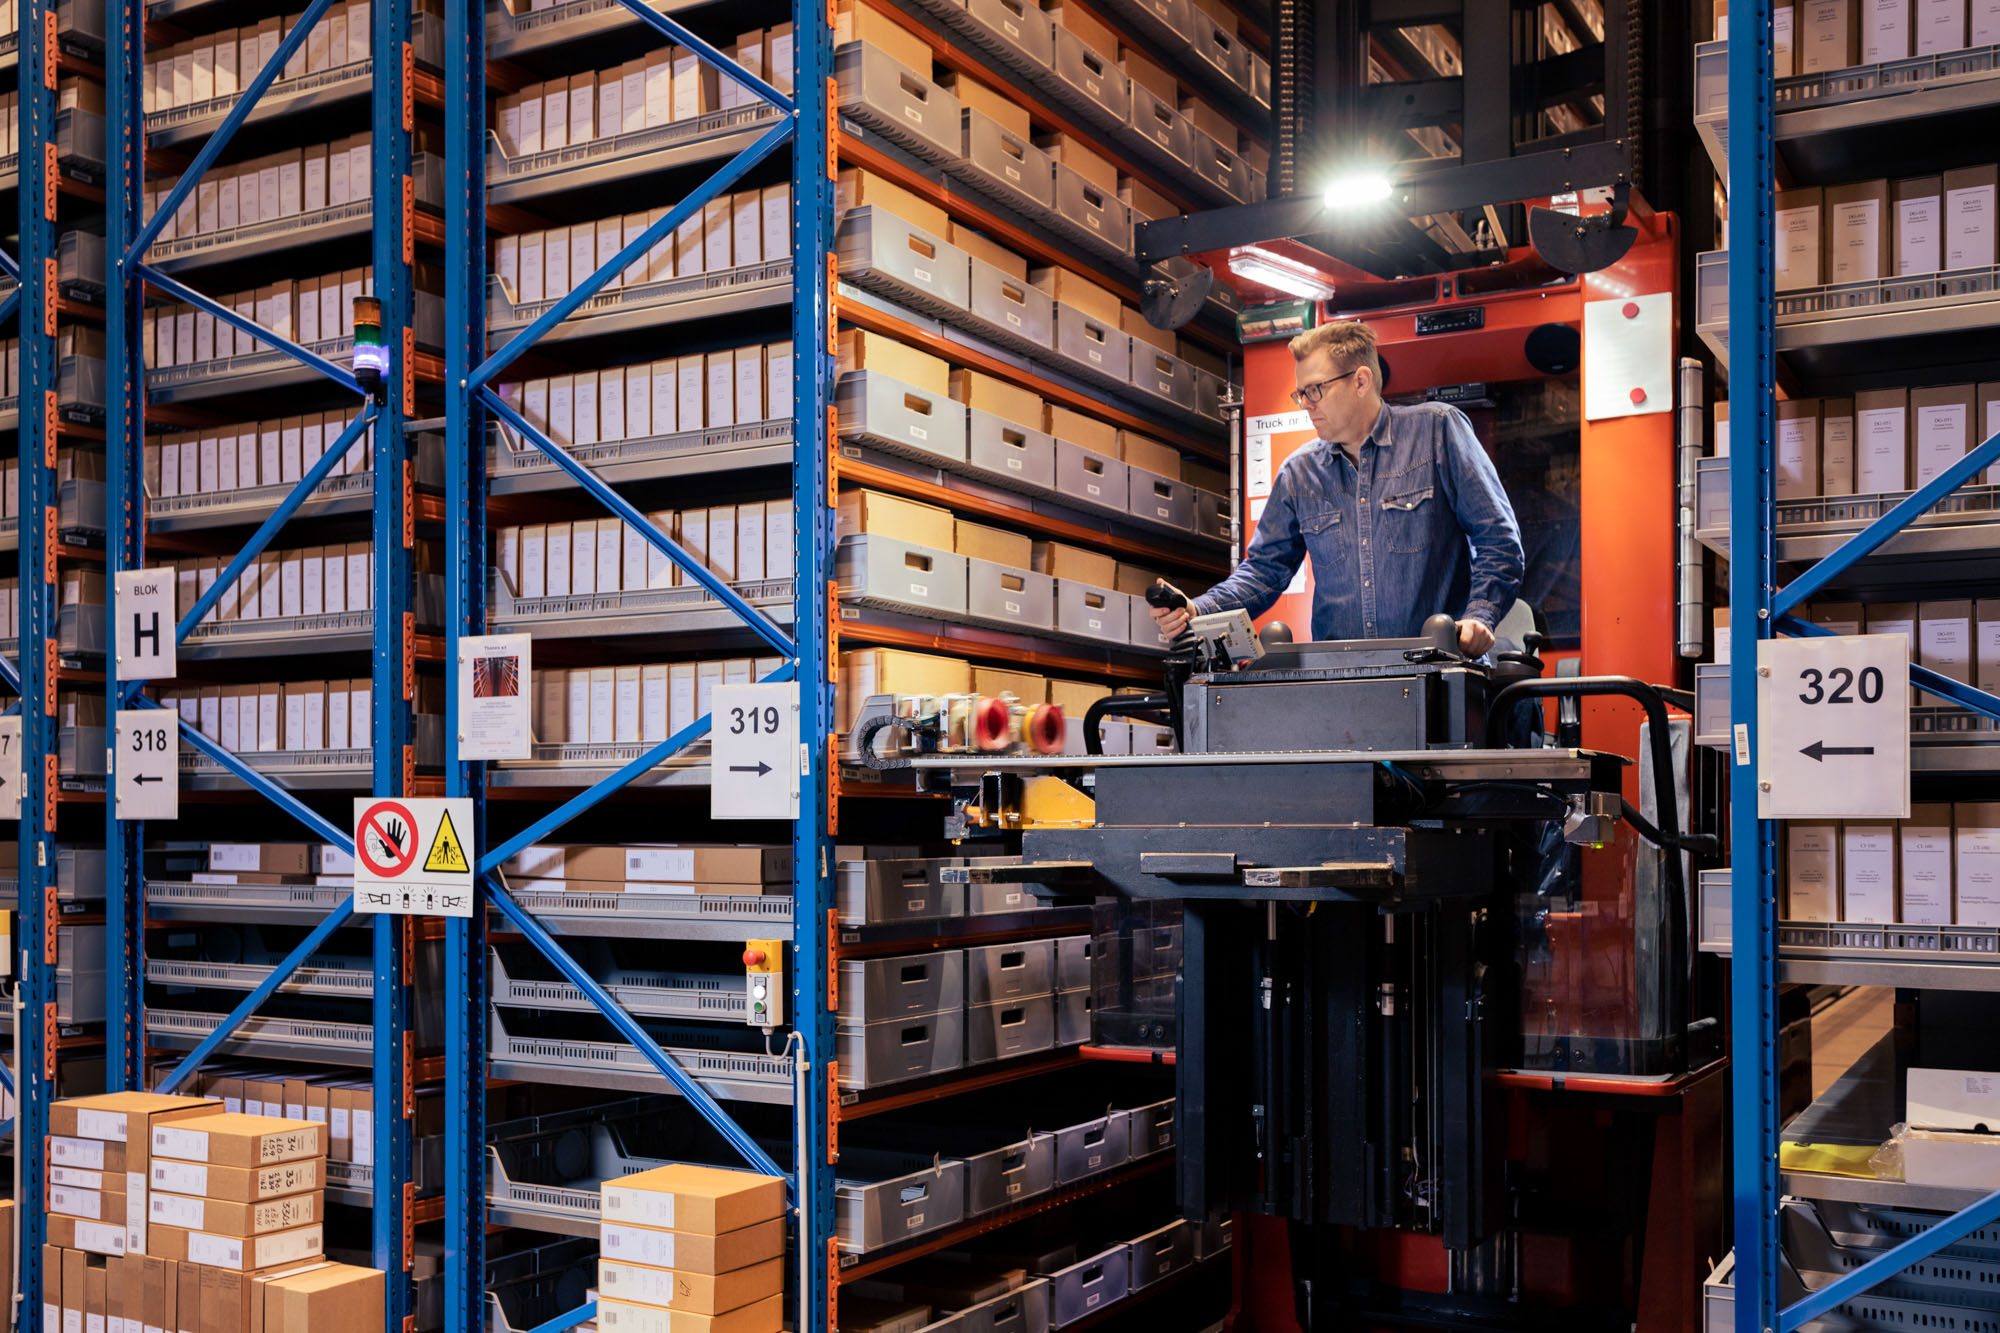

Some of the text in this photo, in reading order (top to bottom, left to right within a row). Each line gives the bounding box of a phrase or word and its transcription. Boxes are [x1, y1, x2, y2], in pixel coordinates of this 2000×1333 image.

[1256, 418, 1283, 430] Truck
[1289, 417, 1298, 426] nr
[134, 585, 158, 596] BLOK
[133, 612, 160, 657] H
[1799, 667, 1884, 705] 320
[730, 706, 779, 735] 319
[132, 729, 167, 752] 318
[288, 1136, 296, 1151] 34
[286, 1170, 294, 1187] 33
